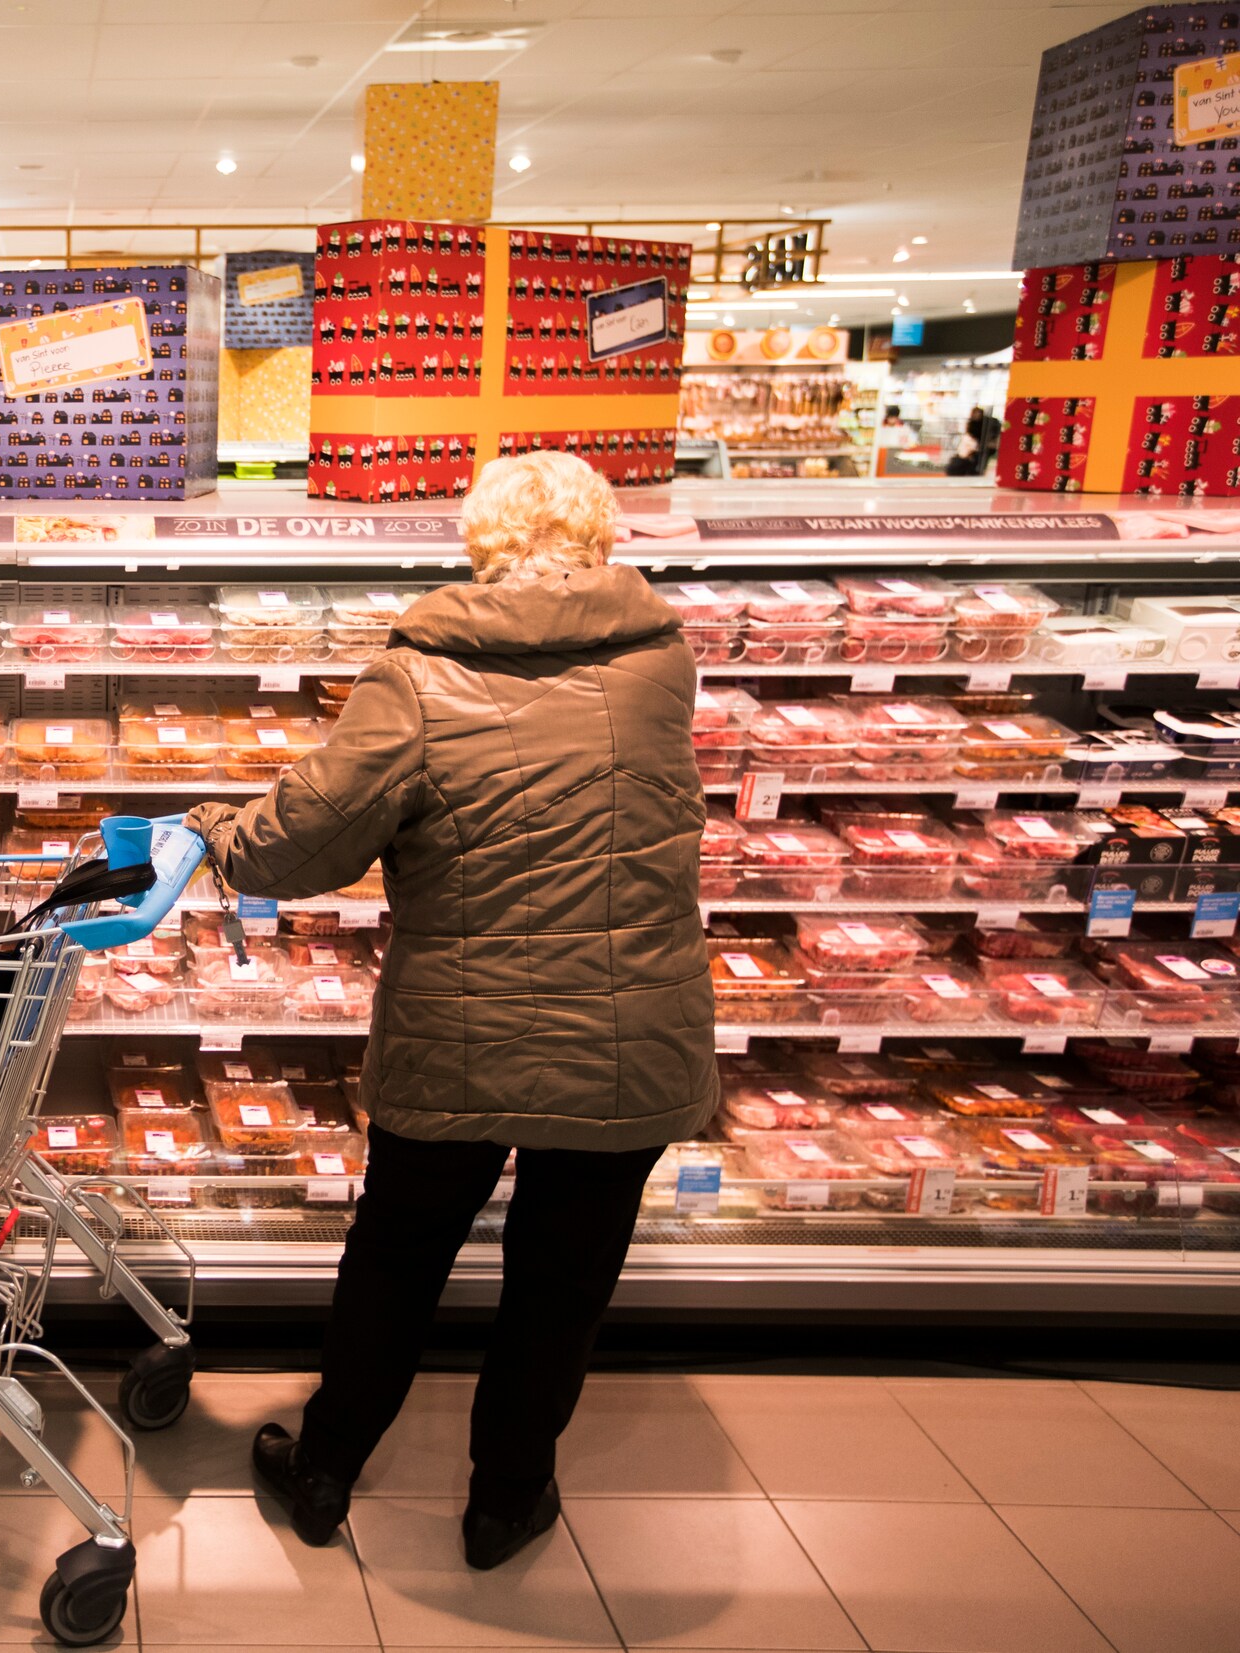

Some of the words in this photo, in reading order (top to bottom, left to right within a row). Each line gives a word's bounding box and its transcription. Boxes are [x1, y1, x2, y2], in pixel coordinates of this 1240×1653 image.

[1192, 97, 1212, 107] van
[1215, 88, 1235, 102] Sint
[14, 354, 31, 364] van
[32, 350, 50, 361] Sint
[50, 344, 70, 355] voor
[29, 361, 73, 377] Pierre
[173, 520, 201, 532] ZO
[206, 520, 228, 532] IN
[237, 518, 280, 536] DE
[286, 518, 376, 536] OVEN
[383, 520, 410, 532] ZO
[415, 520, 444, 532] OP
